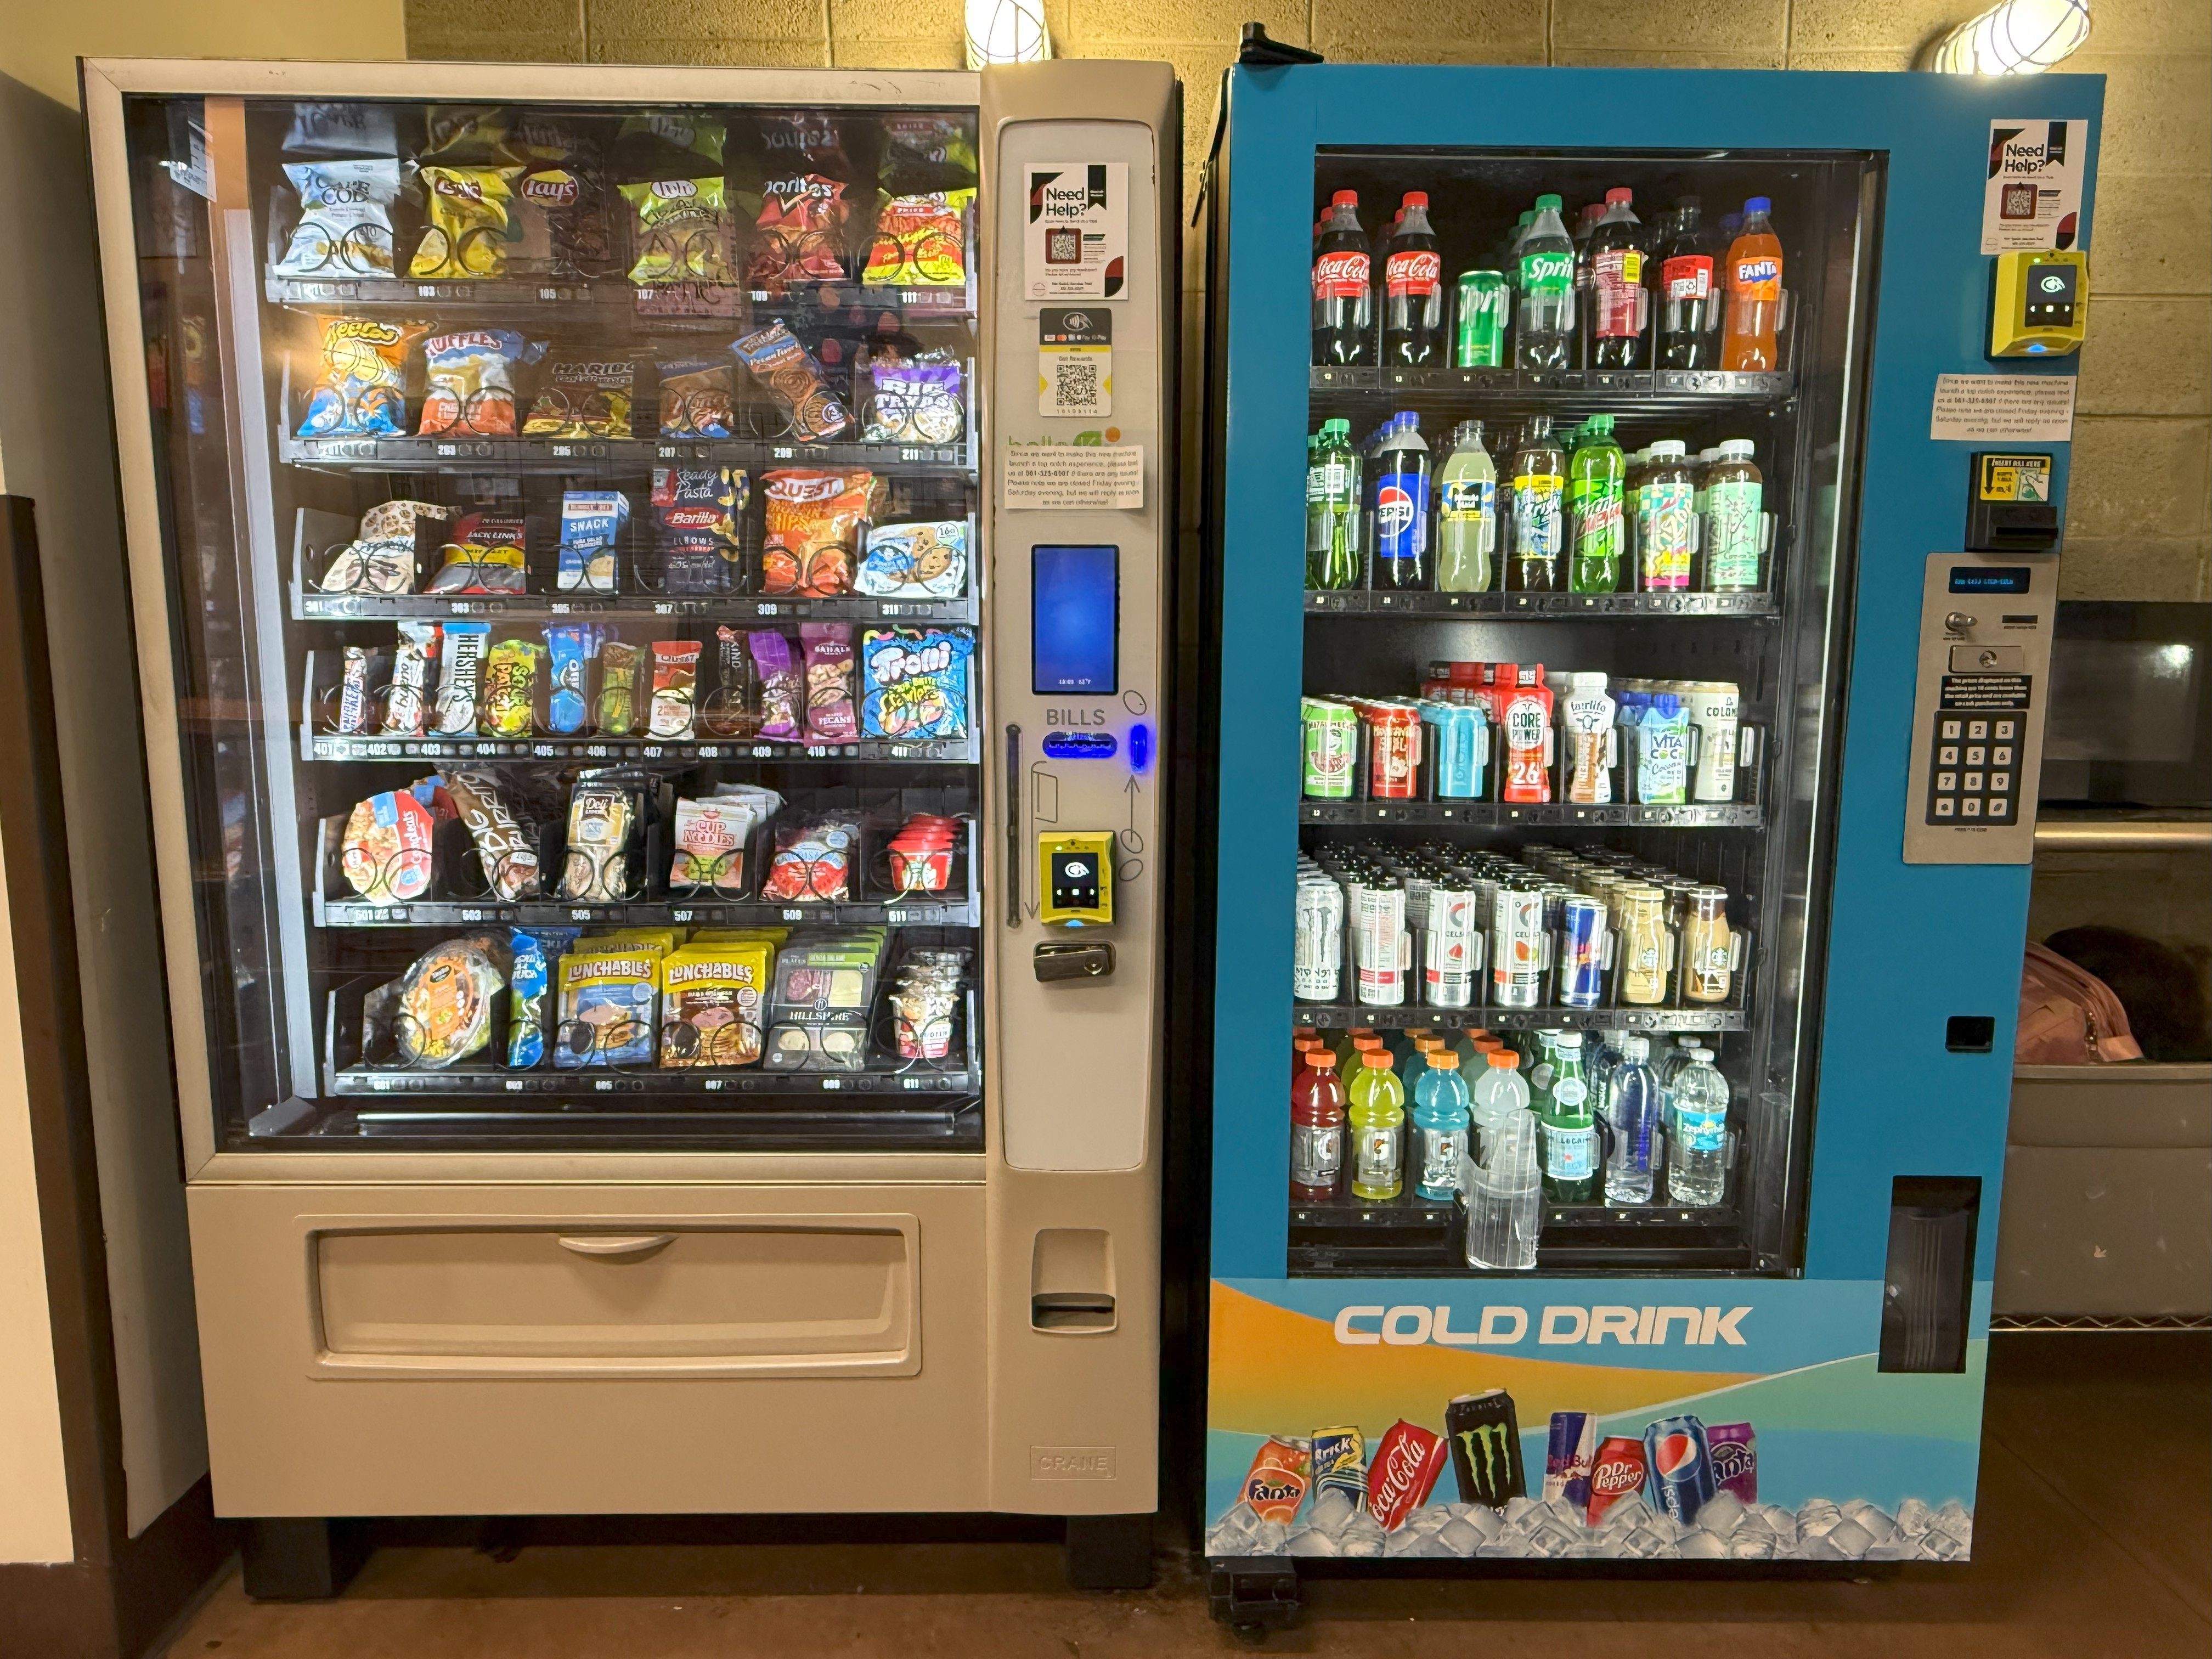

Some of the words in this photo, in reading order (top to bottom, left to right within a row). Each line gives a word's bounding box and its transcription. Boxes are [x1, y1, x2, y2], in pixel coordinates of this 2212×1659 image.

[2006, 144, 2044, 157] Need
[2005, 159, 2045, 174] Help?
[321, 188, 368, 205] COD
[1046, 187, 1085, 201] Need
[1046, 203, 1087, 218] Help?
[1318, 255, 1369, 283] Coca-Cola
[1386, 255, 1438, 282] Coca-Cola
[1528, 257, 1573, 282] Sprit
[539, 289, 556, 299] 105
[637, 289, 653, 300] 107
[902, 291, 917, 303] 111
[902, 449, 919, 460] 211
[673, 482, 713, 500] Pasta
[672, 511, 716, 524] Barilla
[1379, 506, 1410, 517] EPSI
[570, 518, 609, 532] SNACK
[940, 527, 955, 536] 160
[758, 603, 777, 615] 309
[882, 604, 899, 615] 311
[871, 641, 951, 681] Trolli
[1570, 700, 1606, 712] fairlife
[819, 716, 851, 725] PECANS
[1047, 709, 1105, 725] BILLS
[1513, 712, 1541, 728] CORE
[1512, 729, 1540, 741] POWER
[1949, 725, 1954, 734] 1
[1974, 725, 1982, 735] 2
[2001, 725, 2008, 735] 3
[1653, 735, 1683, 748] VITA
[368, 743, 387, 756] 402
[421, 744, 441, 757] 403
[477, 743, 495, 756] 404
[534, 744, 554, 757] 405
[588, 745, 606, 757] 406
[644, 747, 662, 758] 407
[698, 747, 718, 758] 408
[752, 746, 771, 757] 409
[808, 746, 826, 757] 410
[891, 746, 907, 757] 411
[1945, 751, 1953, 760] 4
[1972, 751, 1979, 760] 5
[1999, 751, 2006, 760] 6
[1513, 761, 1539, 785] 26
[1944, 777, 1951, 786] 7
[1970, 777, 1977, 786] 8
[1996, 777, 2004, 786] 9
[585, 797, 608, 810] Deli
[1968, 803, 1975, 812] 0
[465, 809, 508, 853] BIG
[696, 820, 726, 833] CUP
[684, 830, 735, 847] NOODLES
[356, 909, 374, 920] 501
[462, 909, 481, 921] 503
[572, 909, 590, 920] 505
[674, 910, 693, 921] 507
[783, 910, 802, 921] 509
[889, 910, 906, 921] 511
[568, 958, 652, 981] LUNCHABLES
[669, 962, 753, 984] LUNCHABLES
[1334, 1306, 1527, 1345] COLD
[1539, 1306, 1753, 1345] DRINK
[1040, 1457, 1108, 1470] CRANE
[1612, 1462, 1632, 1476] Dr
[1713, 1450, 1755, 1481] anta
[1369, 1430, 1426, 1522] oca-Cola
[1595, 1464, 1643, 1491] Pepper
[1248, 1479, 1301, 1501] Fanta
[1661, 1485, 1679, 1520] epsi
